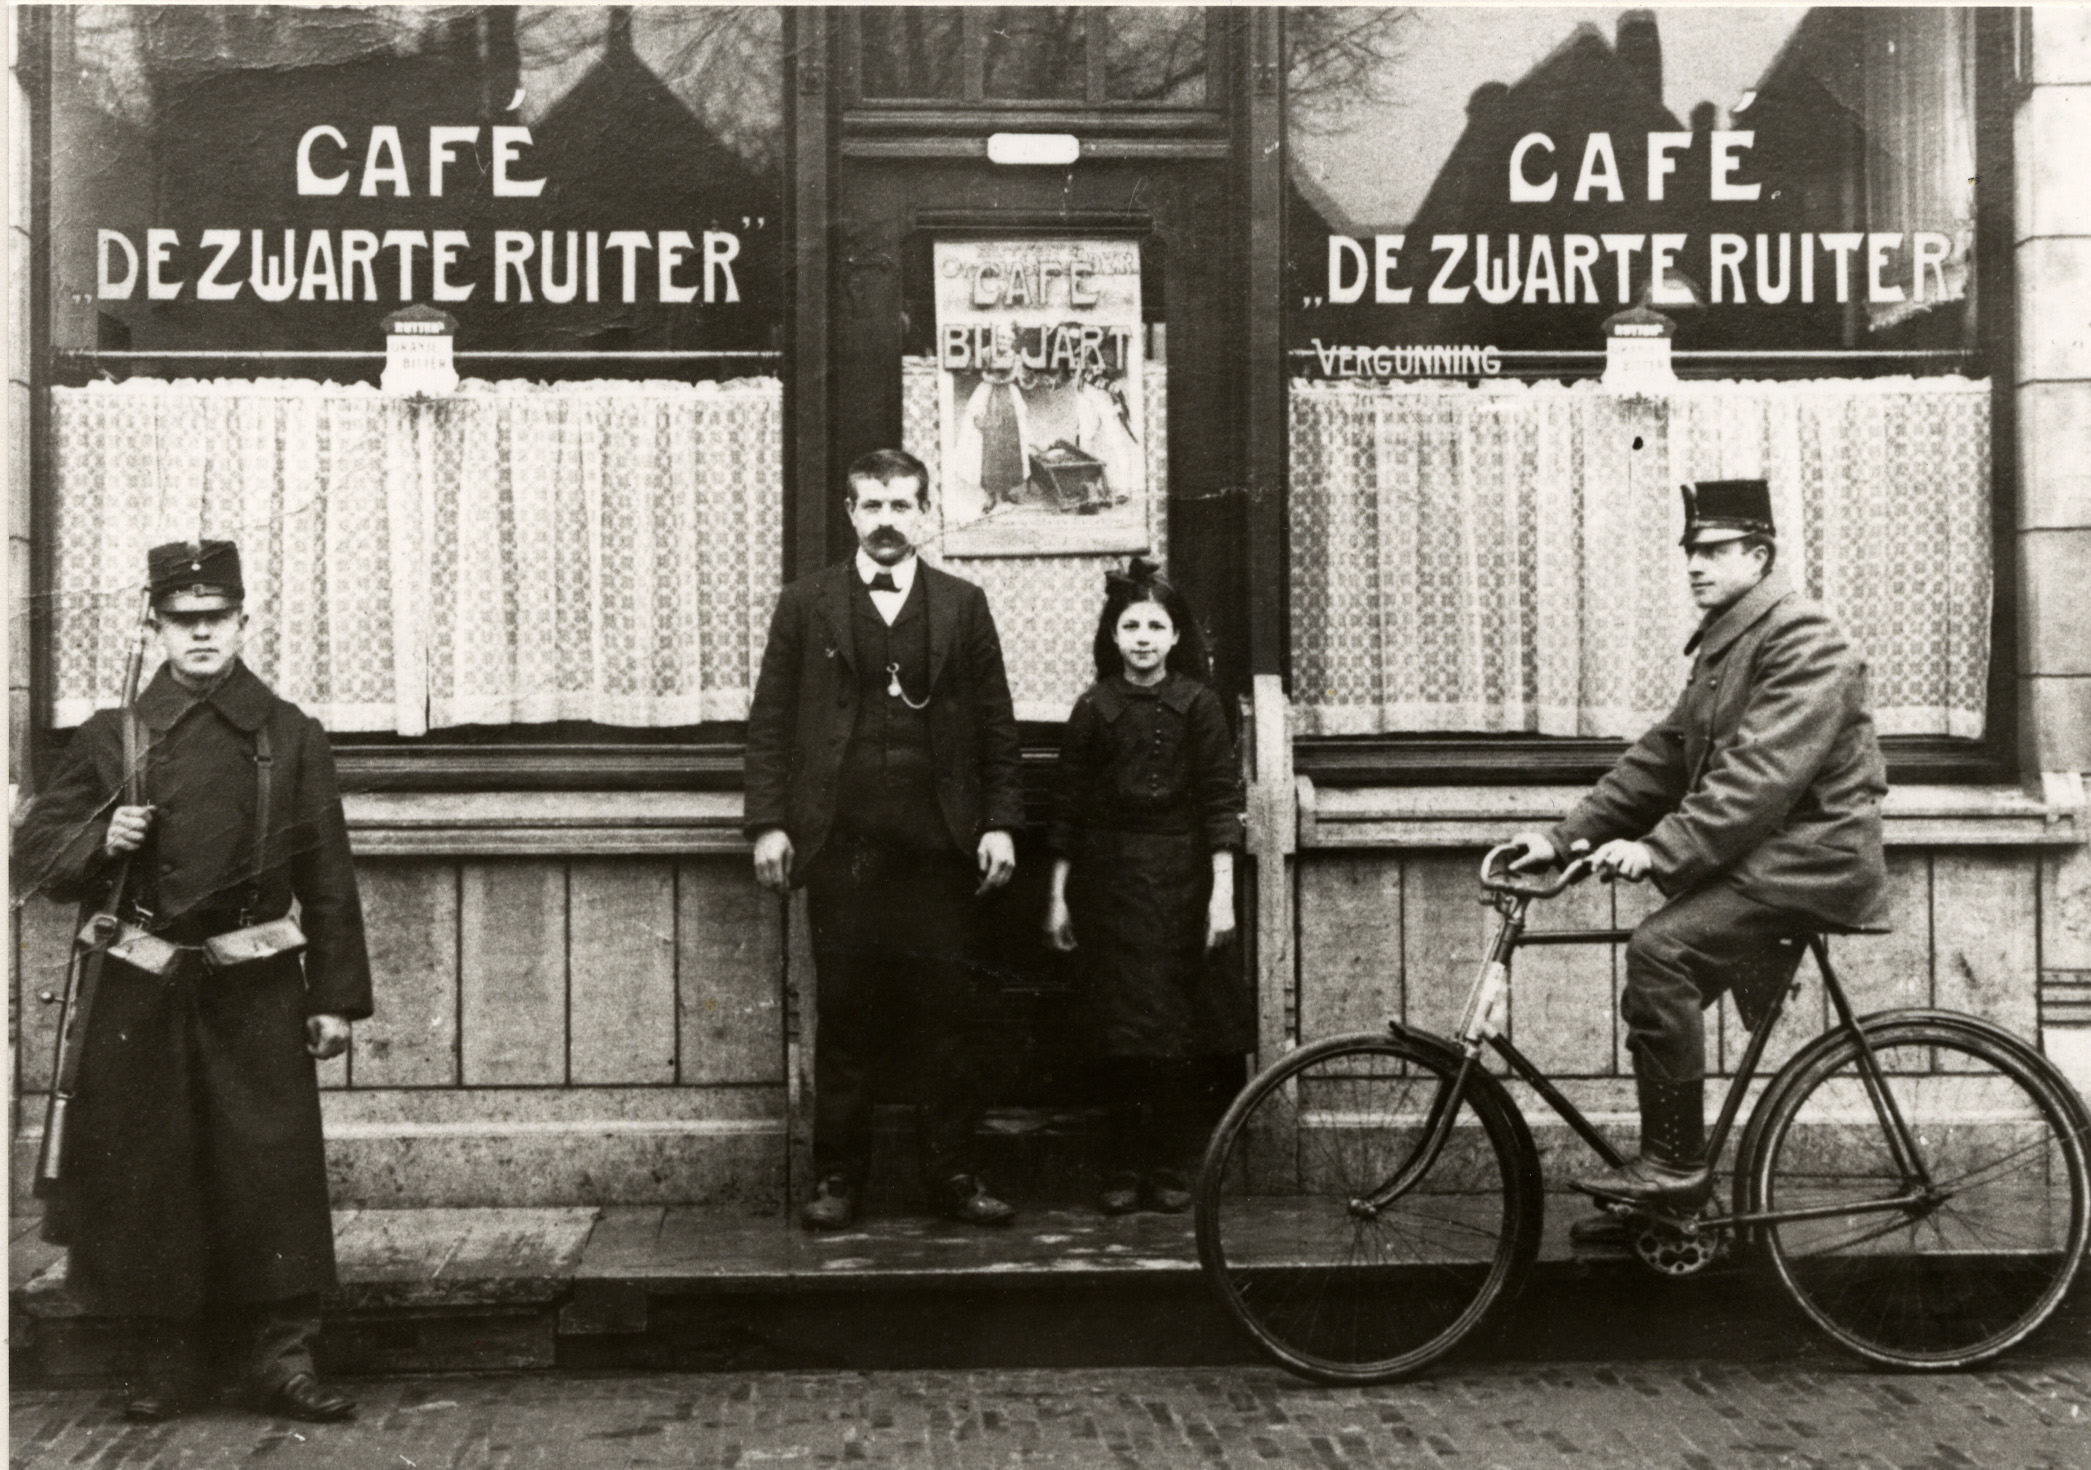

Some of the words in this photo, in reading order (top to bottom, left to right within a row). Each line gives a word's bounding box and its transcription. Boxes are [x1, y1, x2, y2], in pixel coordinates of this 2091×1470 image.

[296, 88, 548, 197] CAFÉ
[1508, 91, 1762, 202] CAFÉ
[196, 228, 476, 302] ZWARTE
[1427, 233, 1697, 304] ZWARTE
[1311, 337, 1501, 376] VERGUNNING
